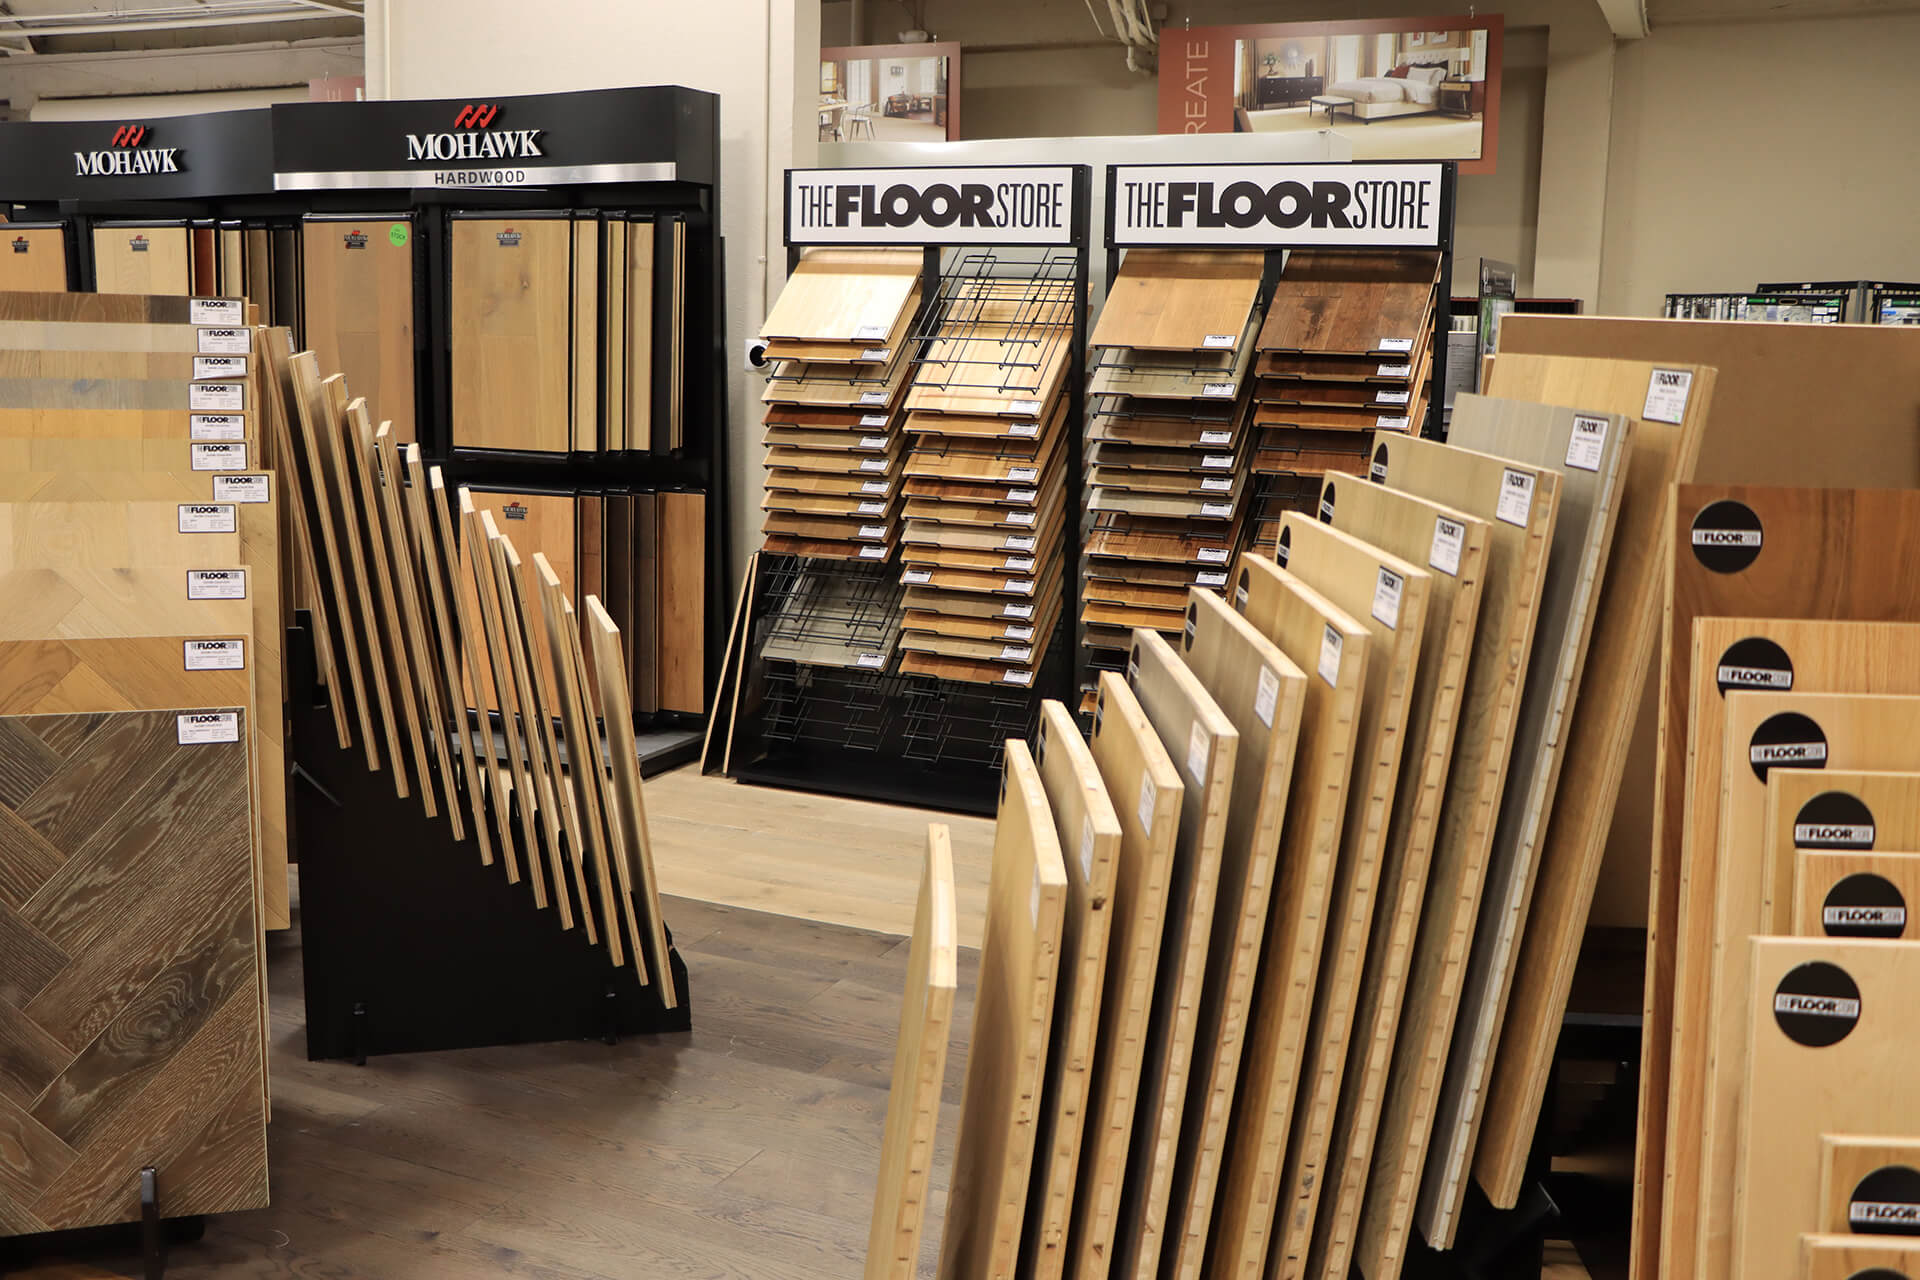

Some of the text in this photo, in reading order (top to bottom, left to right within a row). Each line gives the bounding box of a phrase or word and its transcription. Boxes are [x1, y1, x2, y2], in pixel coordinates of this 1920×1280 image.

[405, 128, 543, 161] MOHAWK
[73, 147, 179, 176] MOHAWK
[434, 169, 526, 185] HARDWOOD
[201, 385, 227, 393] FLOOR
[202, 416, 229, 424] FLOOR
[190, 506, 219, 514] FLOOR
[1704, 533, 1743, 543] FLOOR
[200, 572, 229, 580] FLOOR
[197, 642, 227, 650] FLOOR
[1730, 670, 1773, 683] FLOOR
[190, 714, 221, 723] FLOOR
[1763, 746, 1806, 758] FLOOR
[1808, 828, 1853, 839] FLOOR
[1837, 910, 1883, 921] FLOOR
[1790, 998, 1836, 1012] FLOOR
